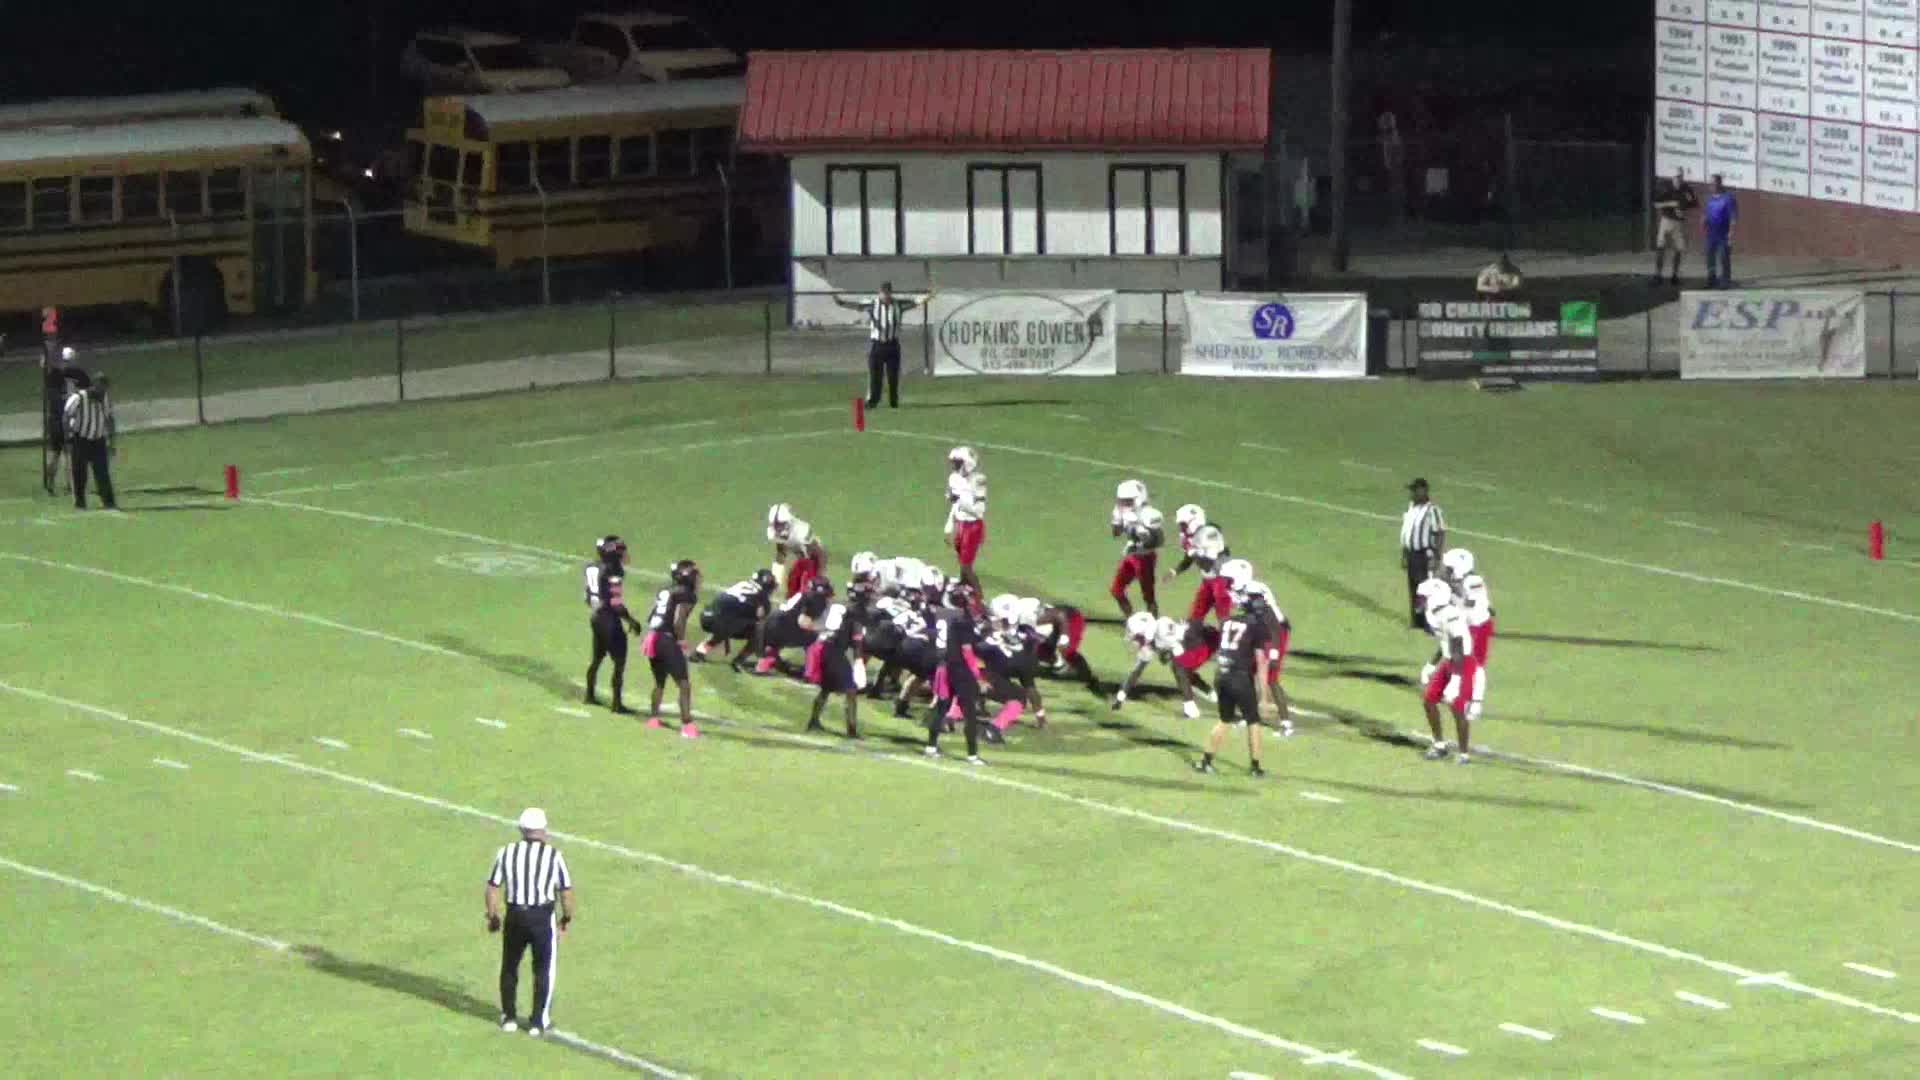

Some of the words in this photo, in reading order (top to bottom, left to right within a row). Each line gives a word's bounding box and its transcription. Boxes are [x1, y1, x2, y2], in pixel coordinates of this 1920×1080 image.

[948, 320, 1020, 345] HOPKINS
[1026, 320, 1085, 345] GOWEN
[1221, 620, 1247, 650] 17
